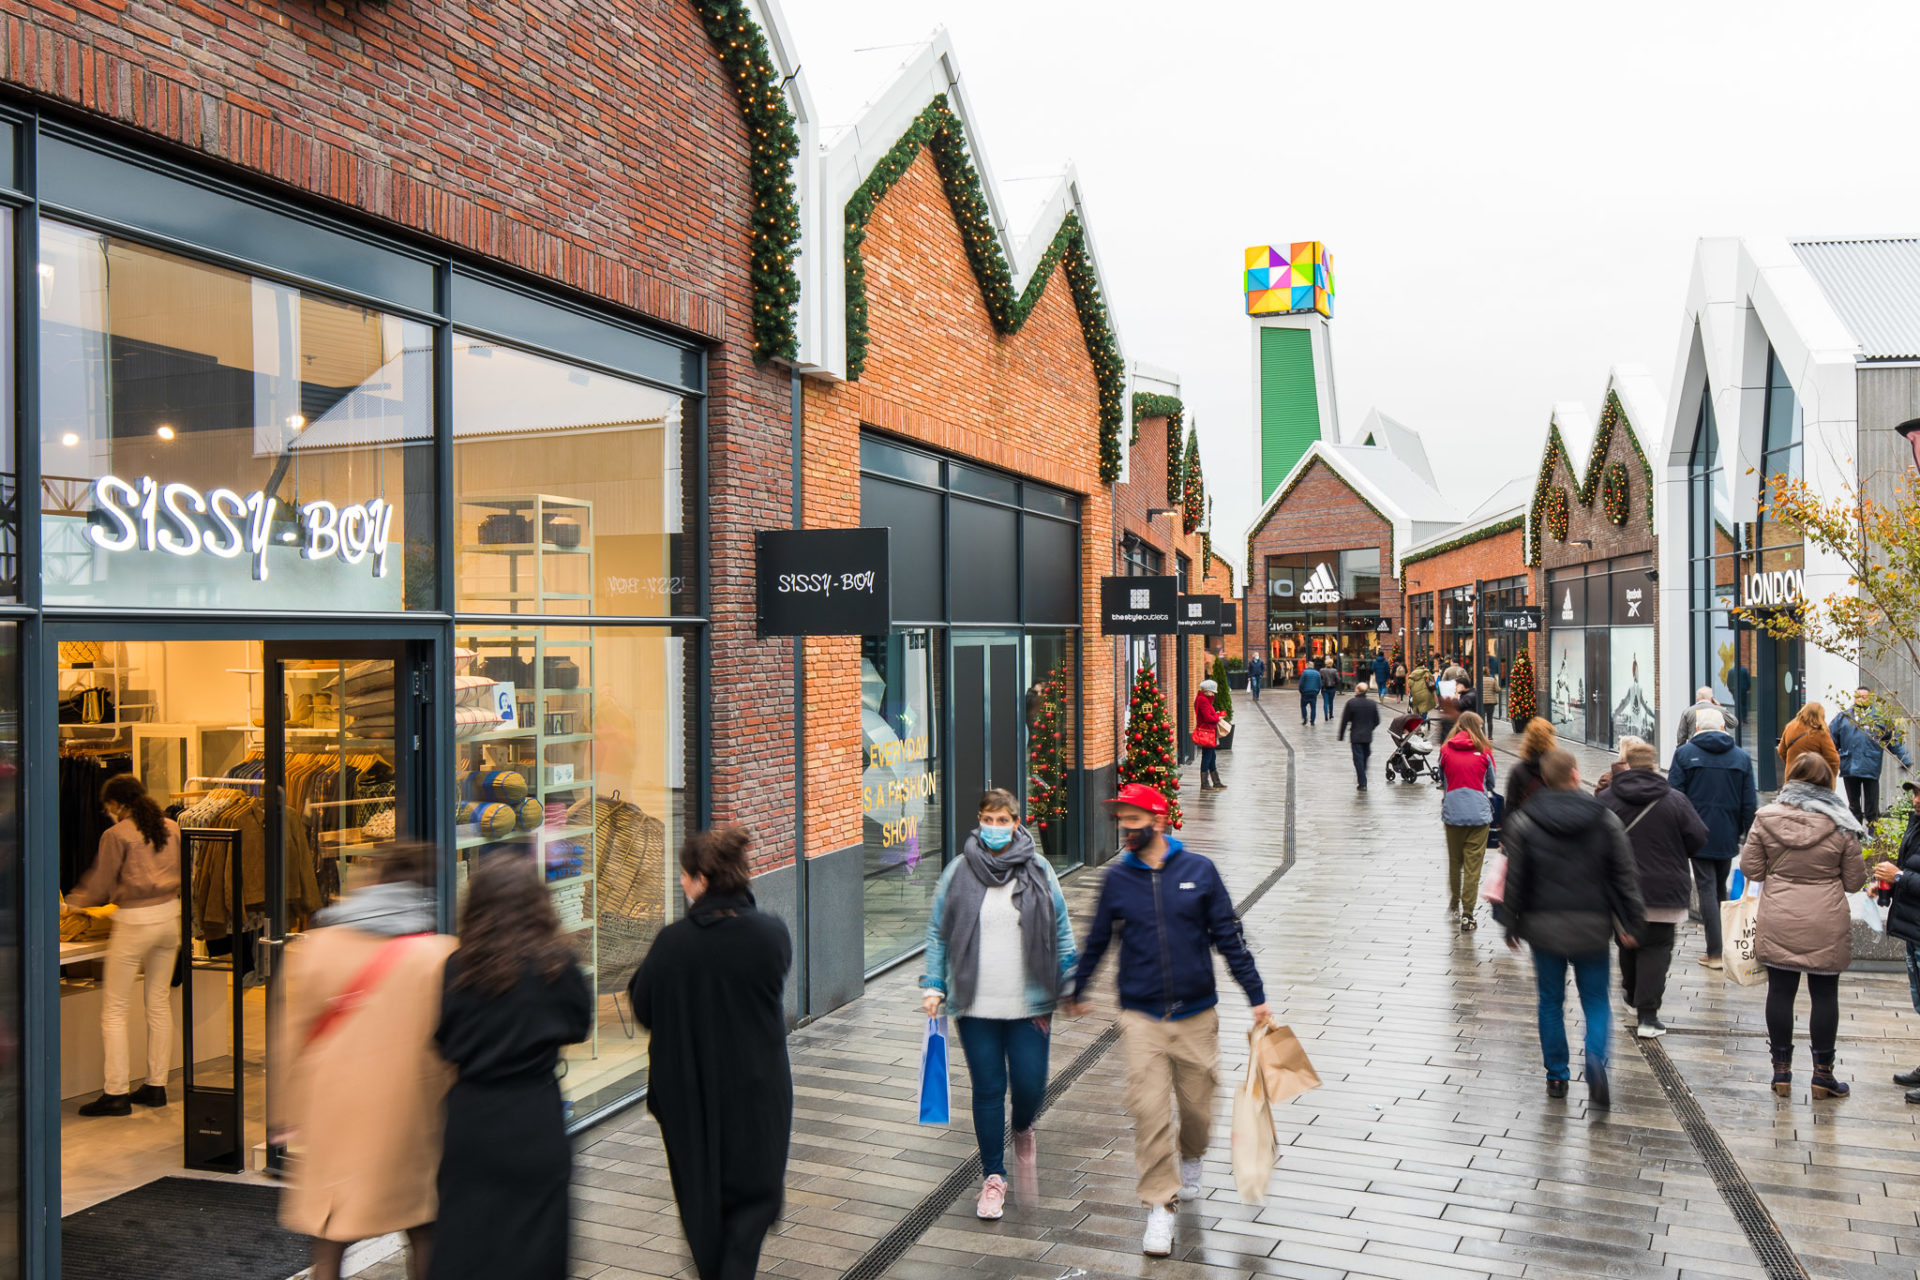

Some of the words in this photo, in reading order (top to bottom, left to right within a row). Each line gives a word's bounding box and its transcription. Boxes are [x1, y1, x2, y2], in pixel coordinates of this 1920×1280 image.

[87, 475, 393, 580] SISSY-BOY
[778, 570, 875, 597] SISSY-BOY
[1300, 589, 1340, 604] adidas
[1744, 569, 1806, 605] LONDON
[870, 735, 928, 769] EVERYDAY
[864, 786, 873, 813] S
[876, 784, 885, 809] A
[888, 771, 936, 807] FASHION
[882, 815, 918, 849] SHOW
[1734, 939, 1749, 950] TO
[1742, 949, 1757, 961] SU
